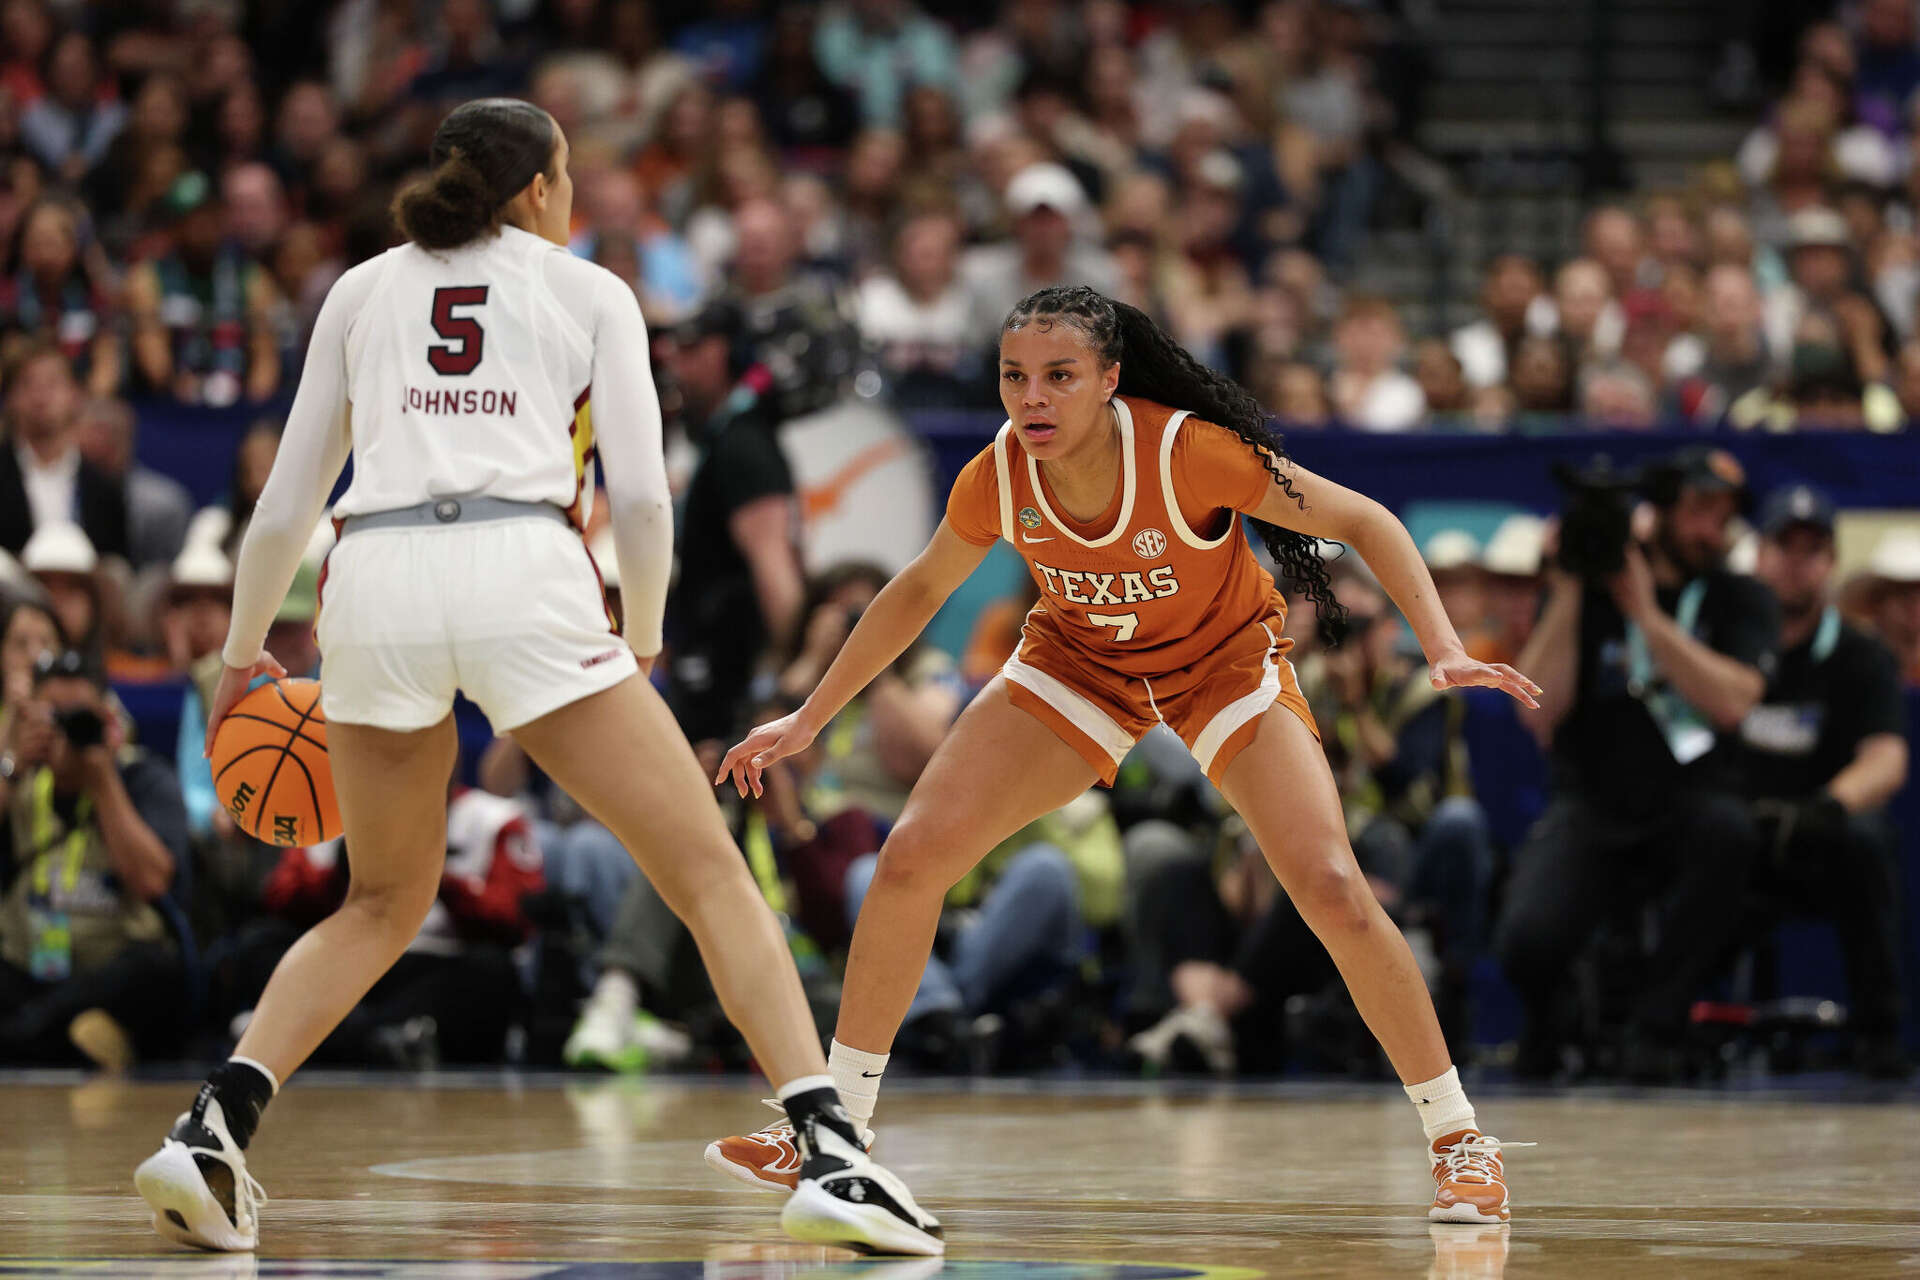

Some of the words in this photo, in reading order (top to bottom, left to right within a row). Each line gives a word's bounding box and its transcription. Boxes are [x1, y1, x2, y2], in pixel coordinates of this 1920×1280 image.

[428, 285, 489, 376] 5
[1135, 530, 1164, 557] SEC
[1033, 559, 1180, 605] TEXAS
[1087, 612, 1140, 642] 7
